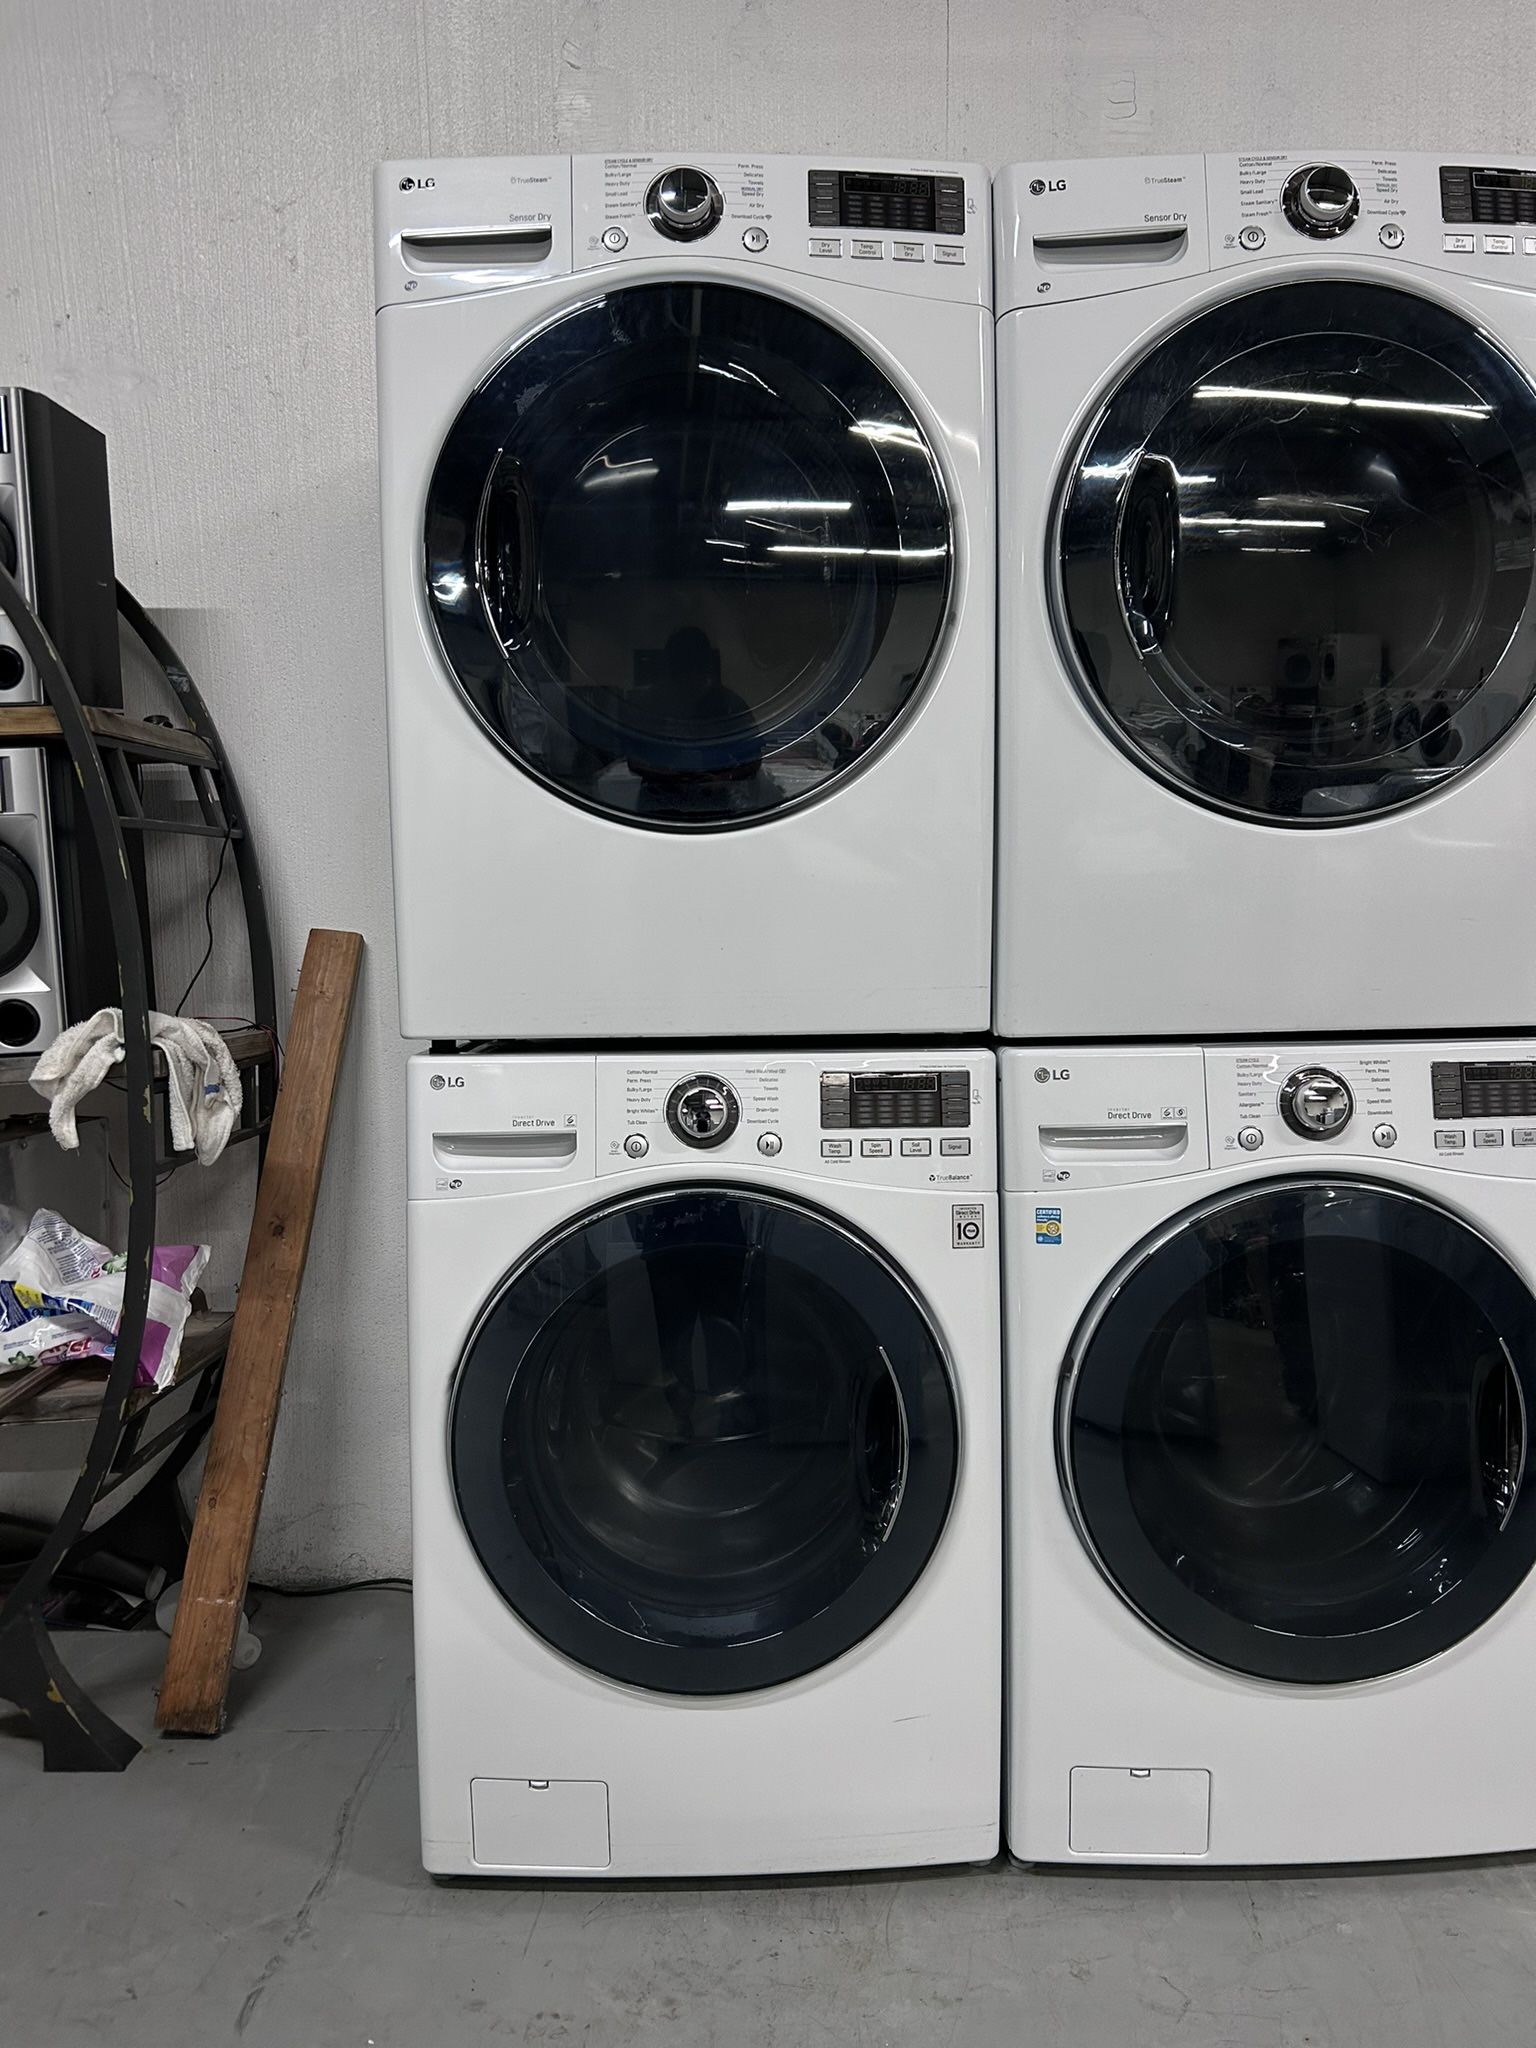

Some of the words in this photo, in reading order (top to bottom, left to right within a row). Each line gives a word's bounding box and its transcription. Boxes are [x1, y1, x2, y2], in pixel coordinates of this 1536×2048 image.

[417, 177, 436, 189] LG
[1049, 180, 1066, 192] LG
[509, 213, 536, 223] Sensor
[537, 212, 552, 223] Dry
[1144, 214, 1171, 223] Sensor
[1173, 213, 1188, 222] Dry
[942, 250, 957, 258] Signal
[1053, 1069, 1070, 1081] LG
[448, 1077, 465, 1088] LG
[1107, 1112, 1130, 1120] Direct
[1132, 1111, 1152, 1119] Drive
[512, 1119, 534, 1127] Direct
[536, 1119, 555, 1127] Drive
[957, 1222, 980, 1240] 10
